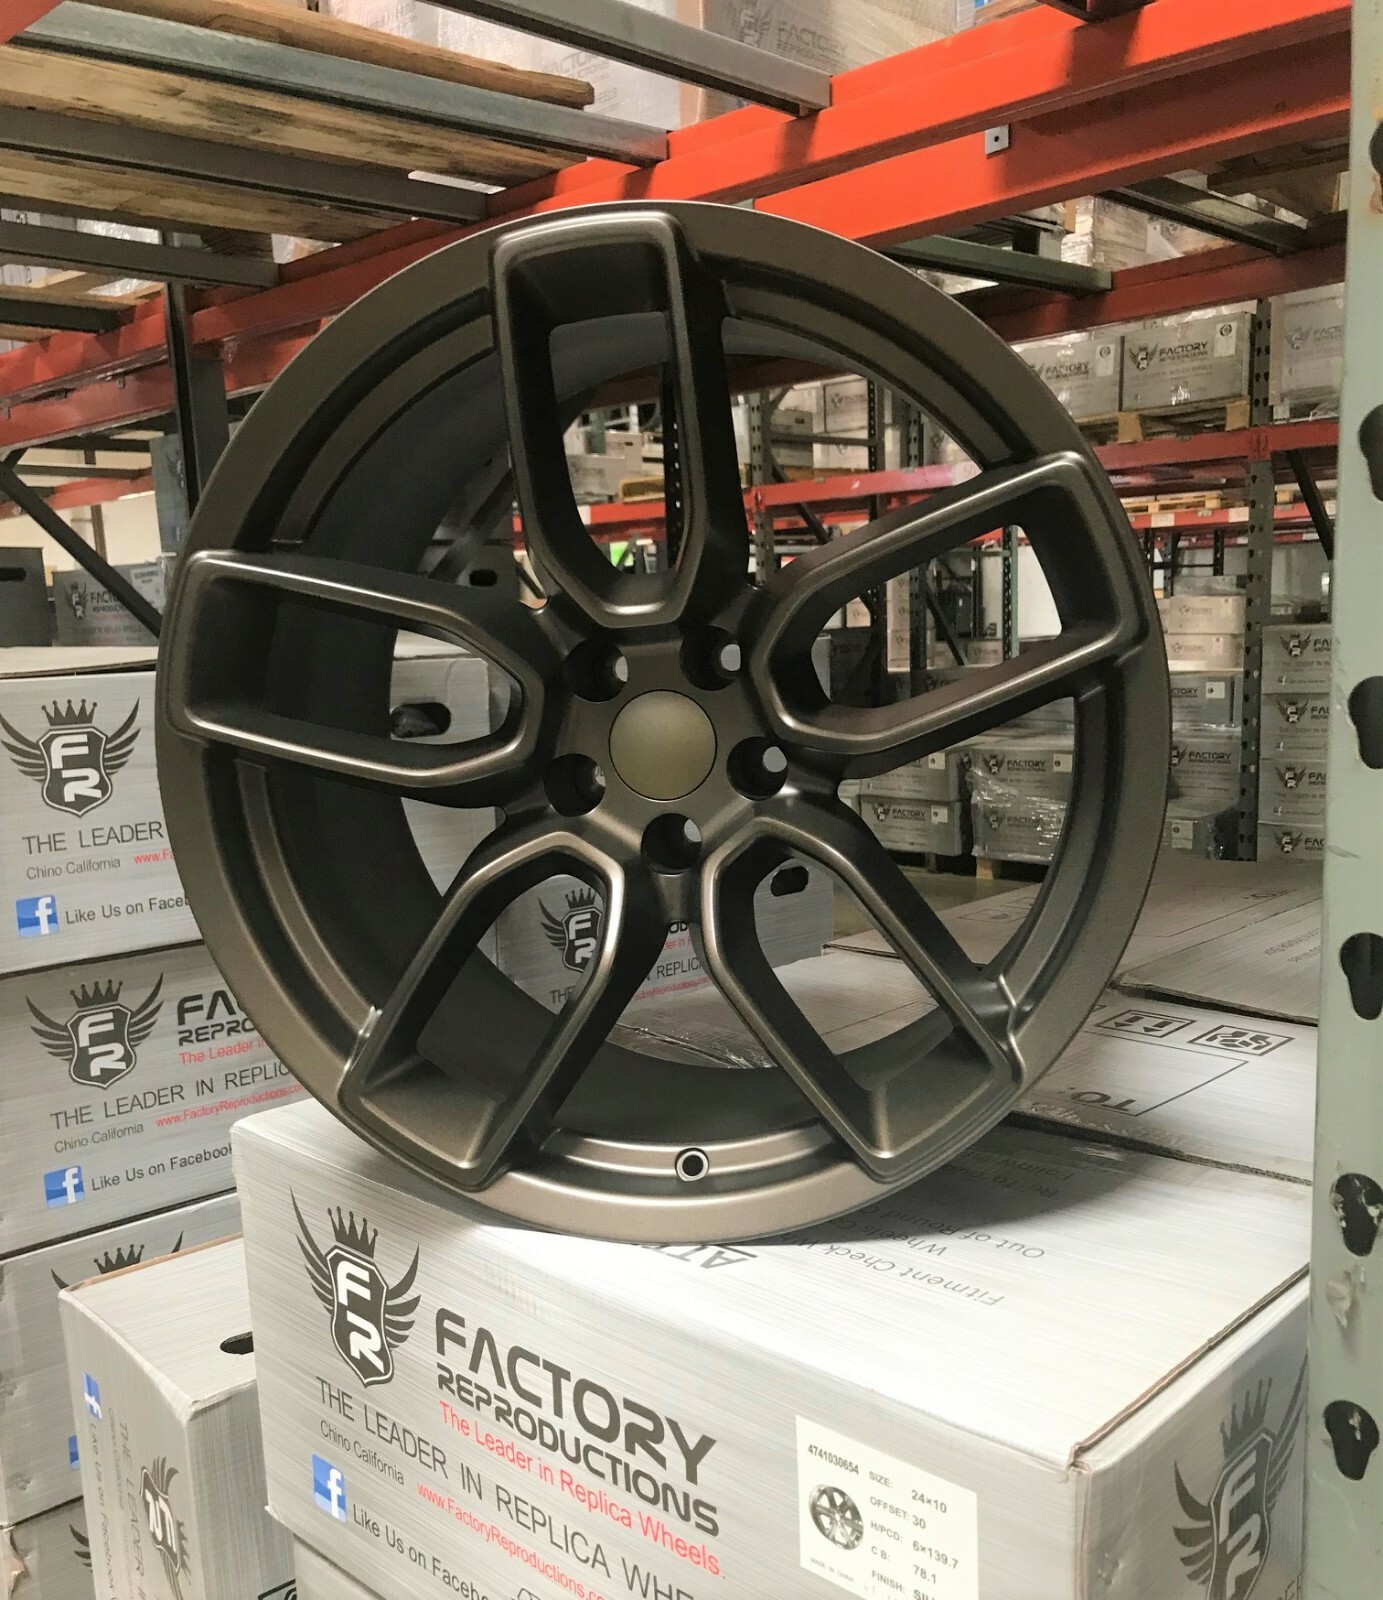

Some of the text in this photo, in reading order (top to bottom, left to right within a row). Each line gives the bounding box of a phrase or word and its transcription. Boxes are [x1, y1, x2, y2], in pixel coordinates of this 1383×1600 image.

[1159, 342, 1208, 357] FACTORY
[1007, 760, 1046, 768] FACTORY
[1189, 751, 1231, 760] FACTORY
[892, 808, 926, 817] FACTORY
[22, 821, 164, 855] THE LEADER
[26, 862, 63, 880] Chino
[66, 856, 121, 876] California
[65, 909, 96, 925] Like
[102, 903, 121, 918] Us
[126, 902, 144, 916] on
[656, 957, 700, 979] REPLIC
[178, 1050, 205, 1066] The
[209, 1040, 256, 1060] Leader
[50, 1062, 291, 1130] THE LEADER IN REPLIC
[54, 1136, 88, 1154] Chino
[91, 1123, 144, 1144] California
[91, 1174, 120, 1192] Like
[125, 1166, 144, 1182] Us
[148, 1162, 165, 1176] on
[884, 1209, 962, 1236] Round
[861, 1225, 948, 1256] Wheels
[964, 1231, 991, 1243] of
[997, 1239, 1045, 1258] Out
[824, 1244, 896, 1272] Check
[900, 1267, 1005, 1306] Fitment
[435, 1308, 718, 1485] FACTORY
[353, 1440, 405, 1486] California
[436, 1361, 720, 1537] REPRODUCTIONS
[807, 1443, 860, 1476] 4741030654
[316, 1376, 355, 1422] THE
[363, 1404, 449, 1480] LEADER
[460, 1462, 483, 1501] IN
[495, 1484, 612, 1580] REPLICA
[440, 1400, 470, 1437] The
[474, 1420, 533, 1473] Leader
[538, 1457, 555, 1486] in
[559, 1469, 633, 1529] Replica
[869, 1470, 894, 1489] SIZE:
[119, 1421, 133, 1470] THE
[126, 1476, 145, 1577] LEADER
[869, 1496, 926, 1530] OFFSET: 30
[352, 1503, 381, 1538] Like
[386, 1525, 405, 1554] Us
[408, 1546, 427, 1571] on
[870, 1520, 903, 1543] H/PCD:
[871, 1570, 906, 1594] FINISH:
[912, 1564, 937, 1585] 78.1
